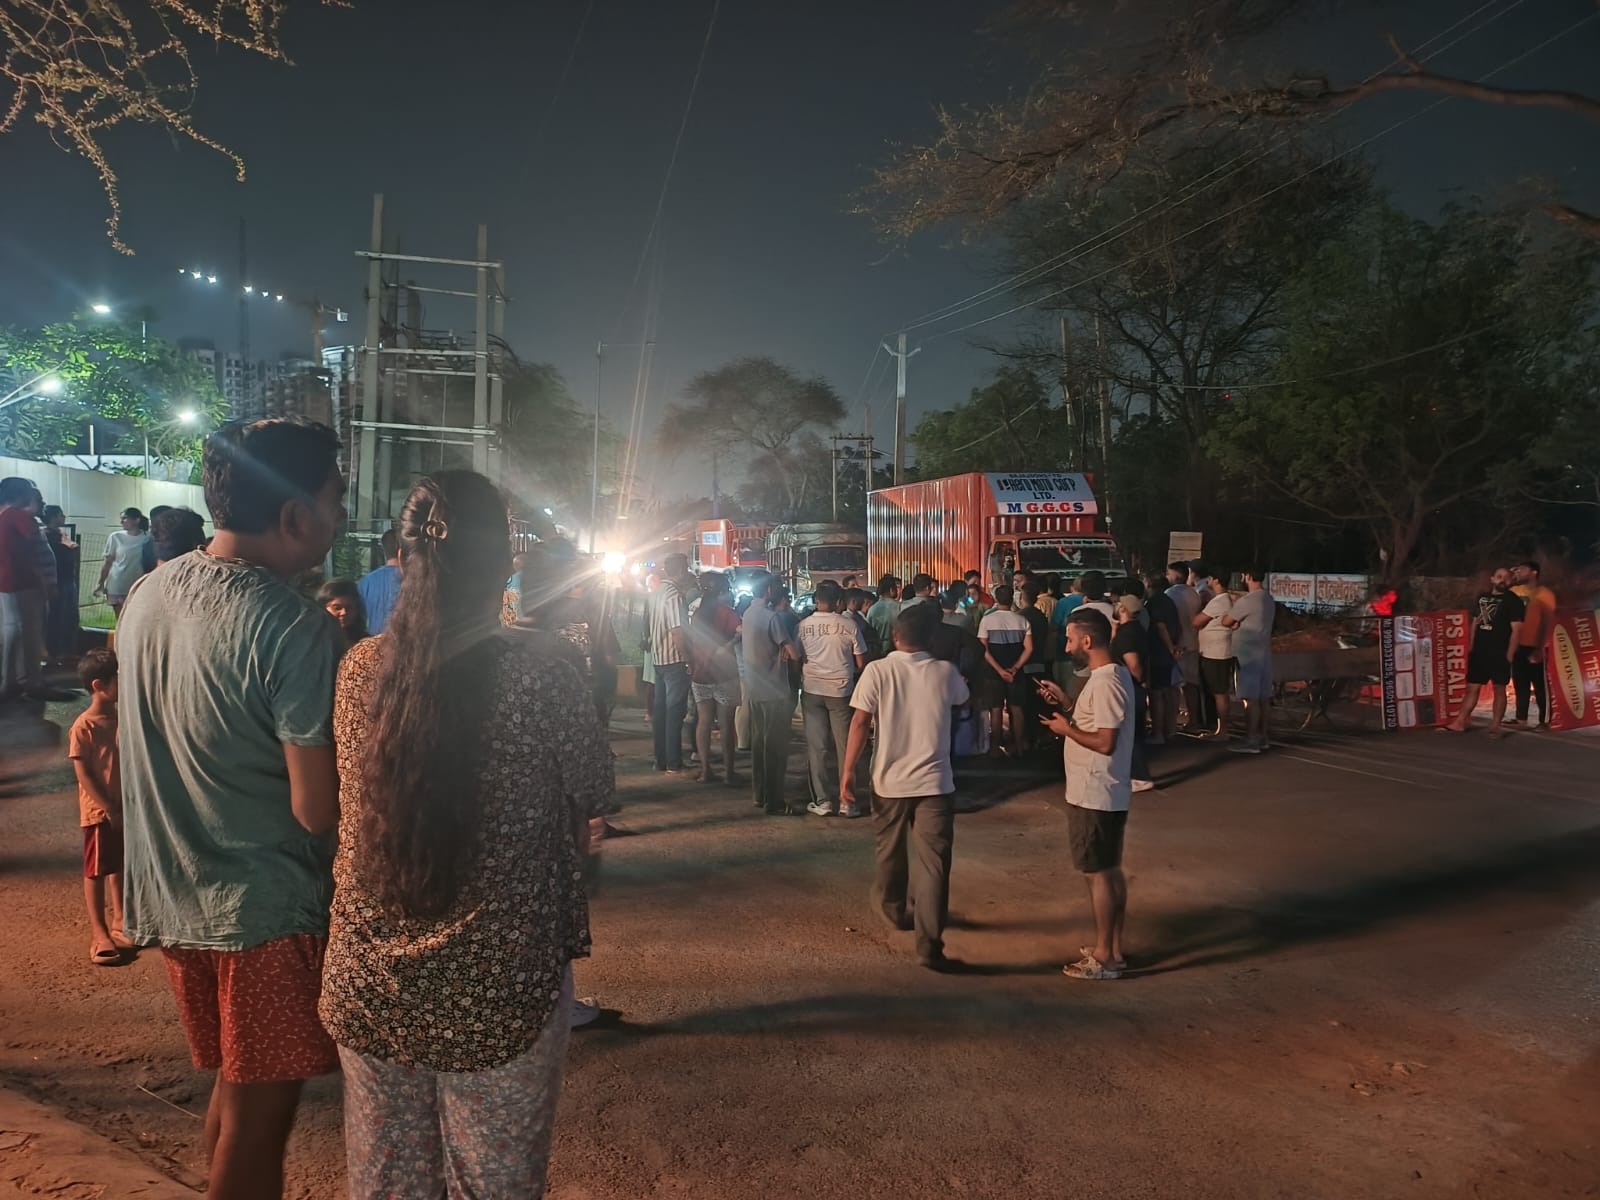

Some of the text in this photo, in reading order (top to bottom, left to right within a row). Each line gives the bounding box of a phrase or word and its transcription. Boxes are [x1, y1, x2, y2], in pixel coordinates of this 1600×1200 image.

[1033, 491, 1056, 500] LTD.
[1446, 614, 1464, 639] PS
[1573, 617, 1593, 648] RENT
[1583, 656, 1600, 687] SELL
